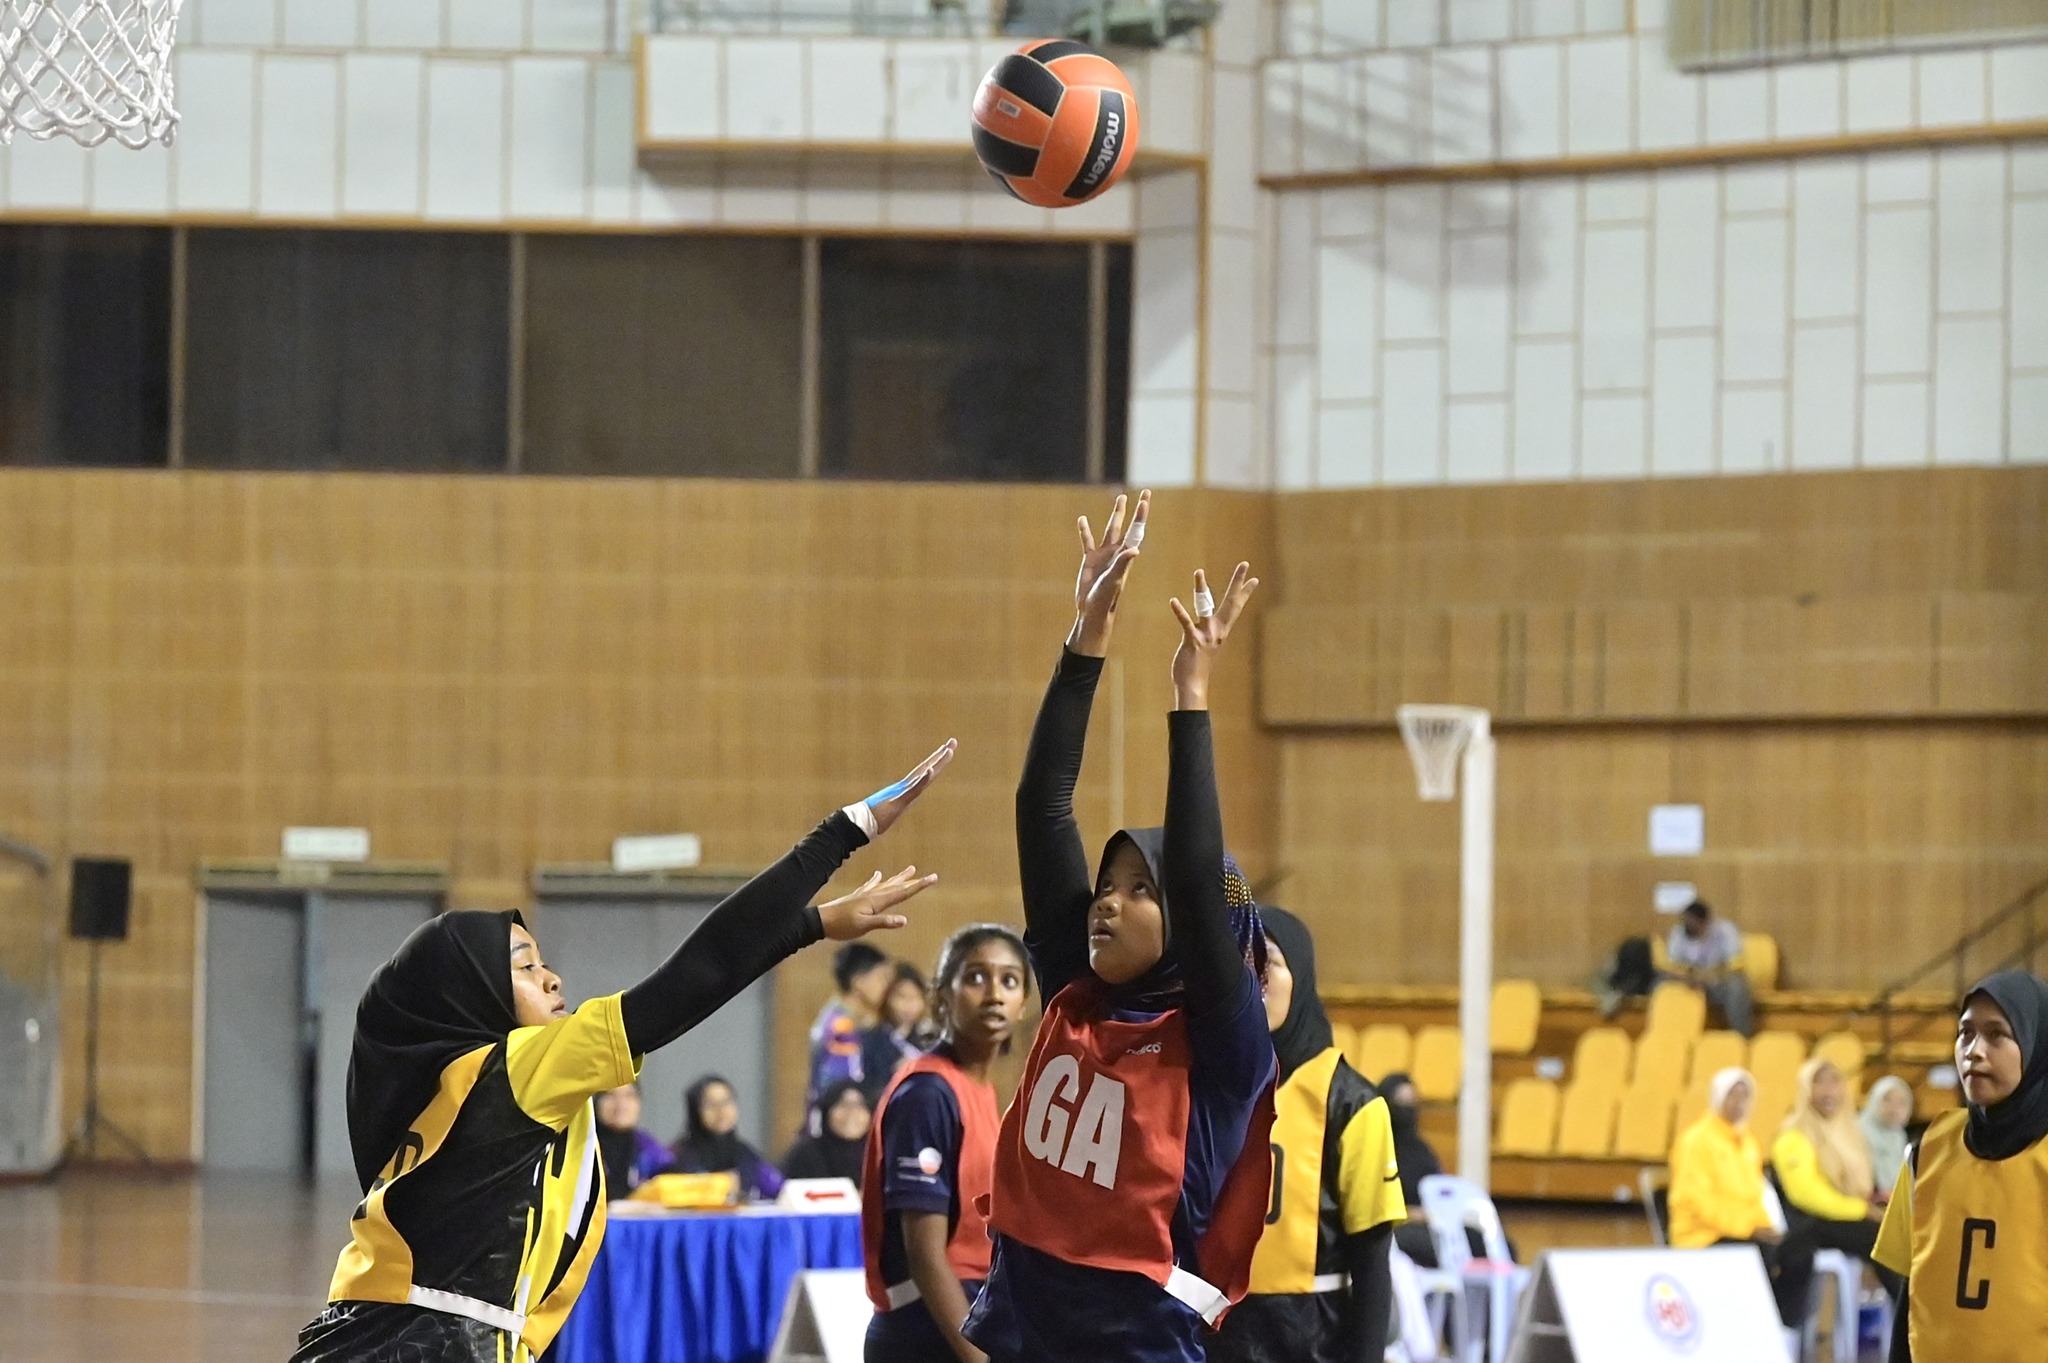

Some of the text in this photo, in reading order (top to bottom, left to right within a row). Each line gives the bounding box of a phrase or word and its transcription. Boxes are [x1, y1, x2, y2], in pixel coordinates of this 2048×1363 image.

[1085, 112, 1119, 184] molten
[1024, 1054, 1125, 1190] GA
[1957, 1218, 1996, 1310] C
